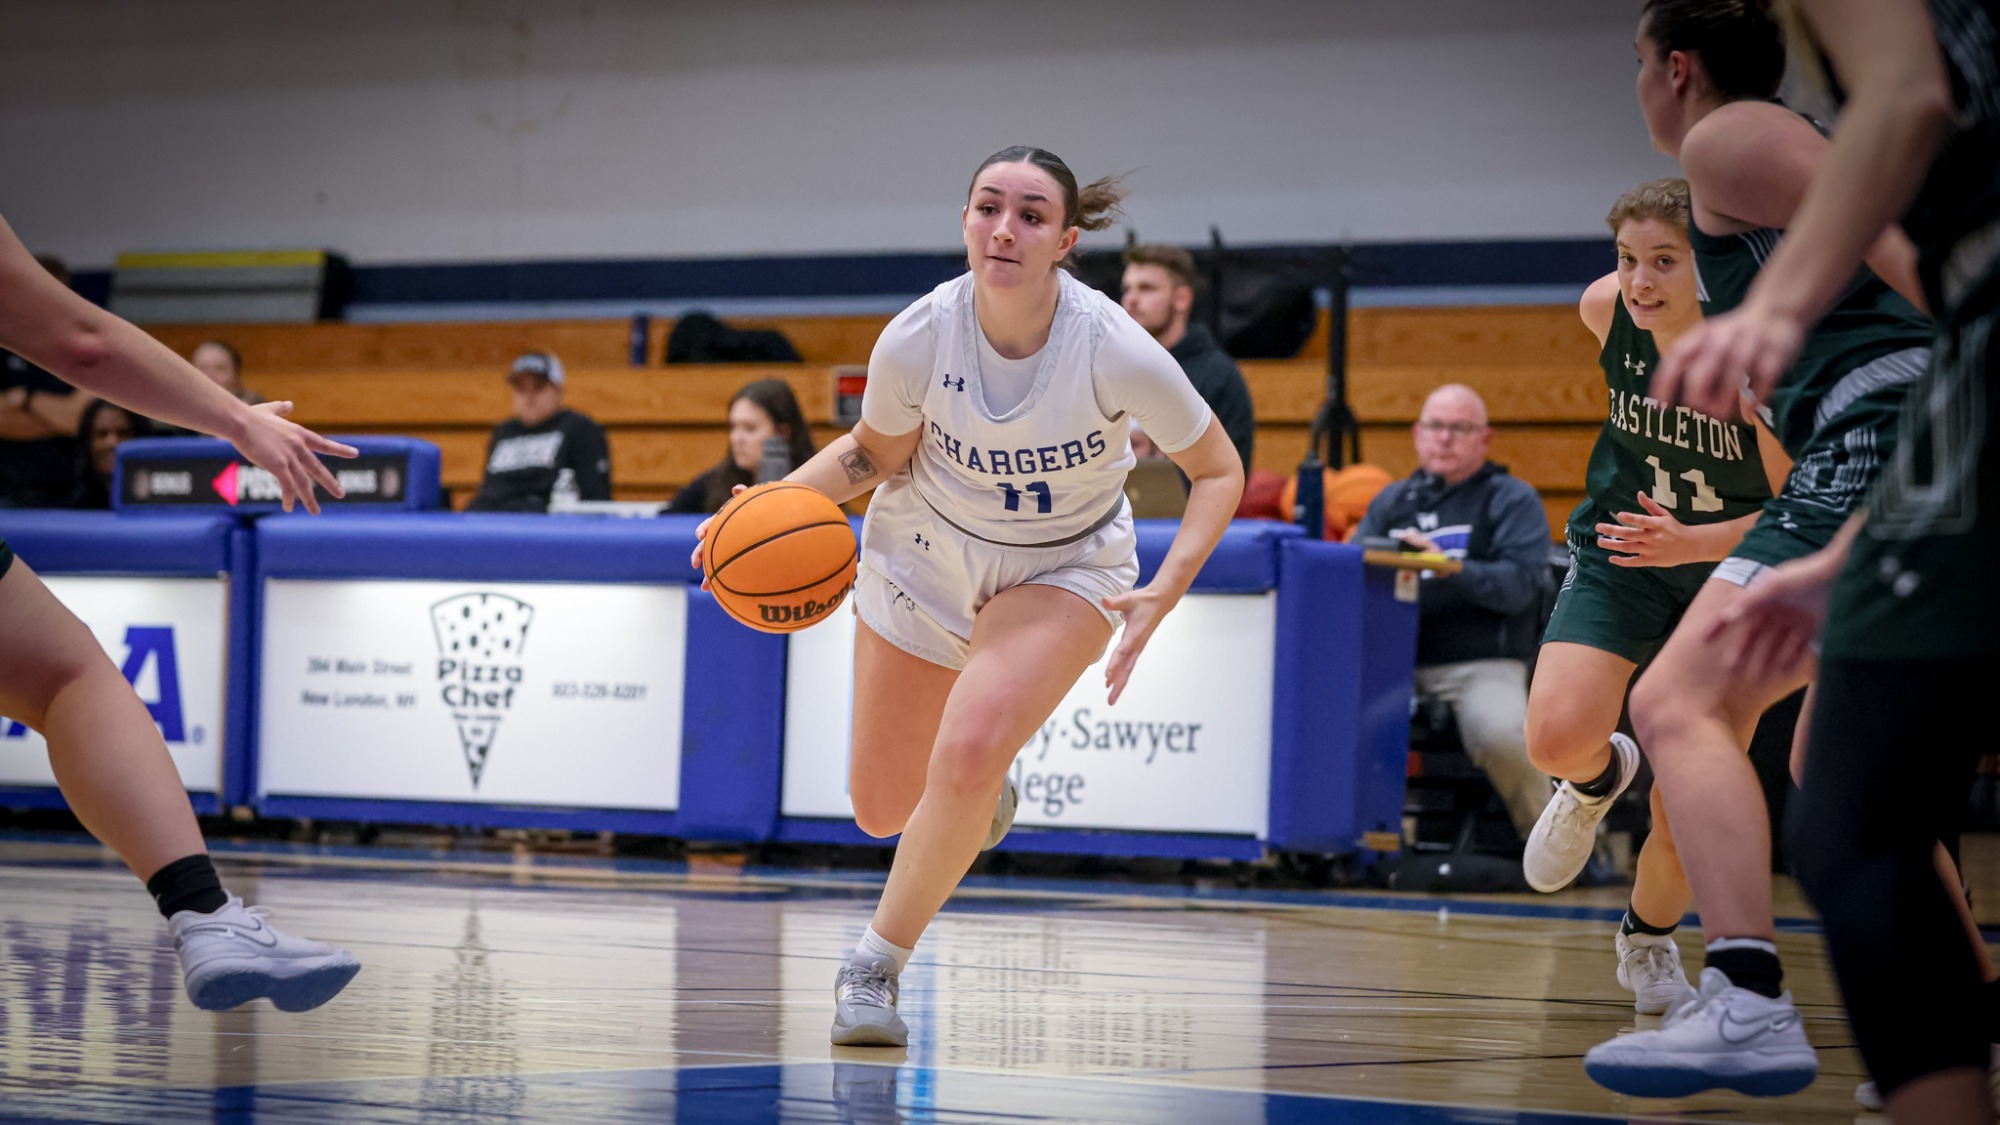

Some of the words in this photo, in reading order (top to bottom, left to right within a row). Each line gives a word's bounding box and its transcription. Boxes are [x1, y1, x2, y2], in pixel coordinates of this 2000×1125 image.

[930, 420, 1107, 476] CHARGERS
[996, 480, 1053, 514] 11
[1644, 454, 1724, 513] 11
[758, 581, 850, 624] Wilson
[438, 658, 523, 683] Pizza
[441, 684, 515, 708] Chef
[1015, 756, 1085, 818] lege
